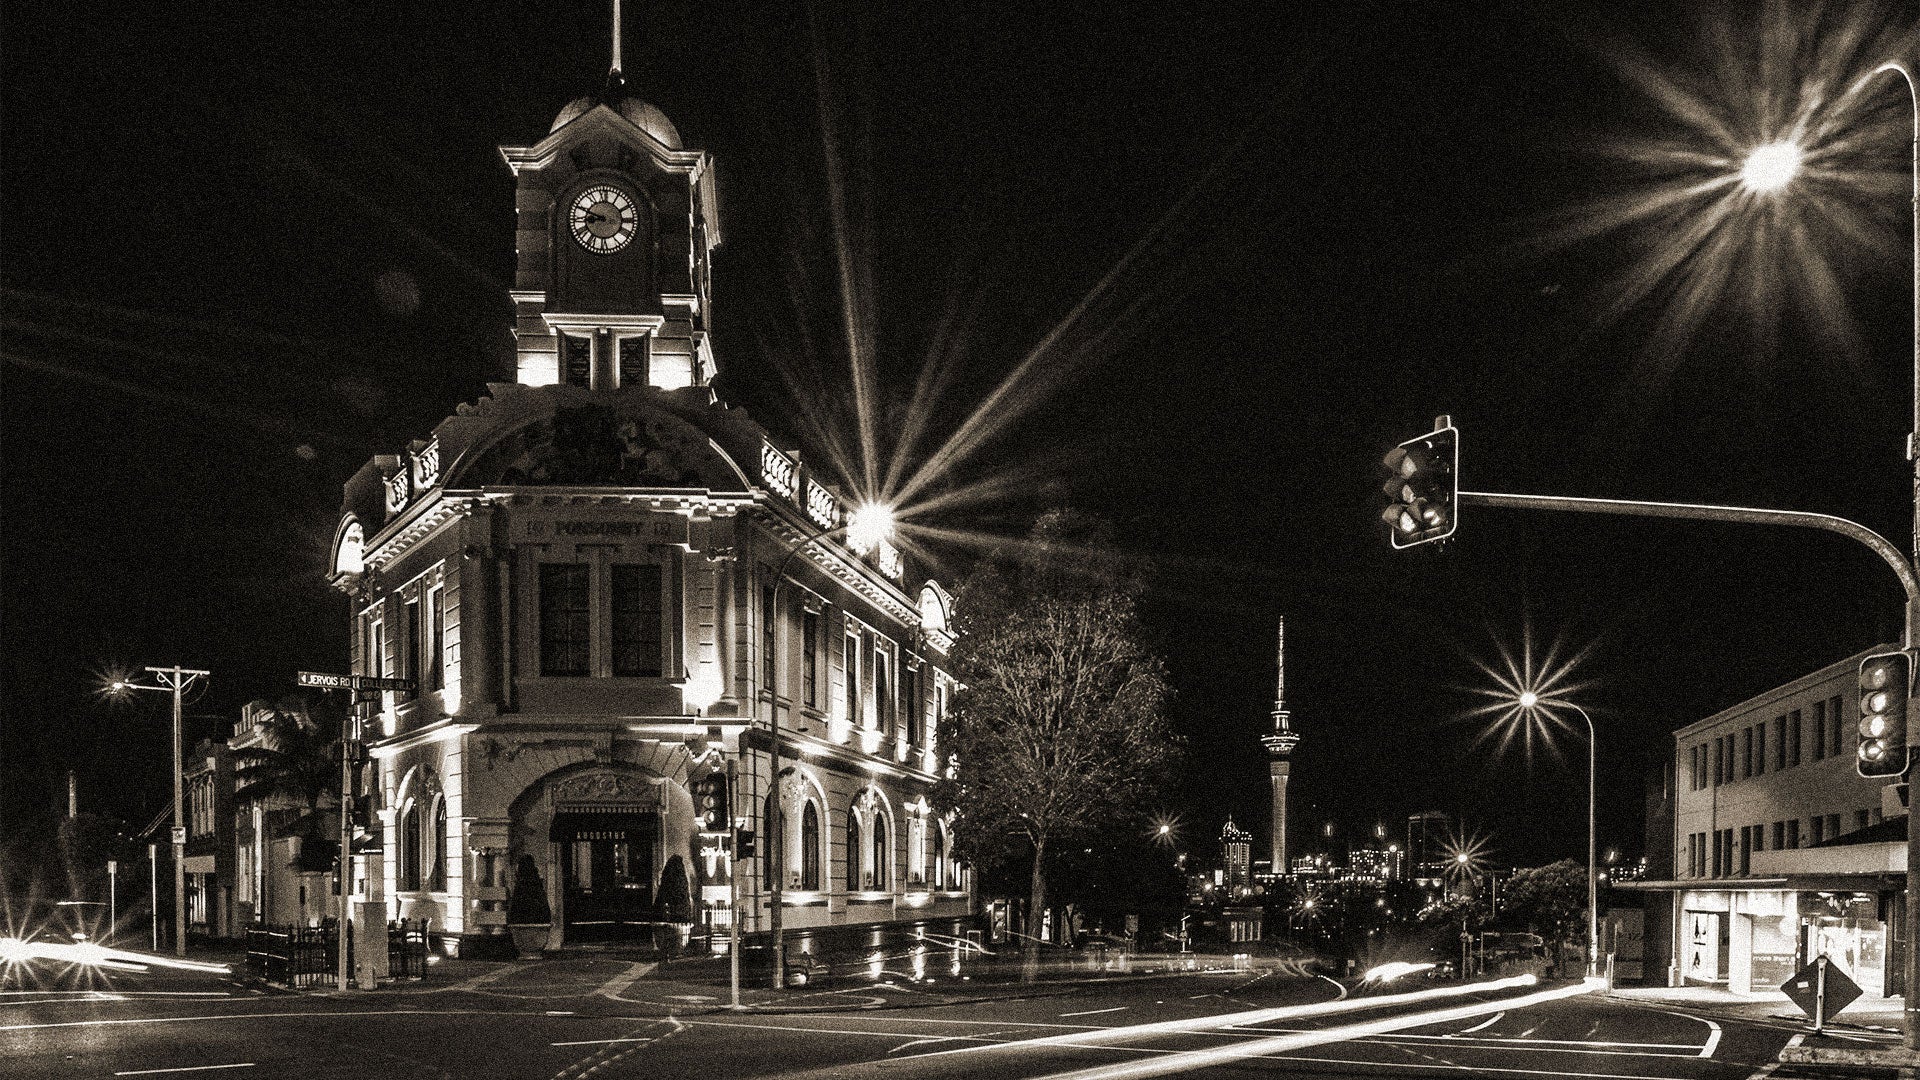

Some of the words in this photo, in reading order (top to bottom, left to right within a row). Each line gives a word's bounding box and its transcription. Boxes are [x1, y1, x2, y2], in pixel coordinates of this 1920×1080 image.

[308, 675, 338, 686] JERVOIS
[340, 678, 351, 687] RD
[576, 831, 625, 840] AUGUSTUS
